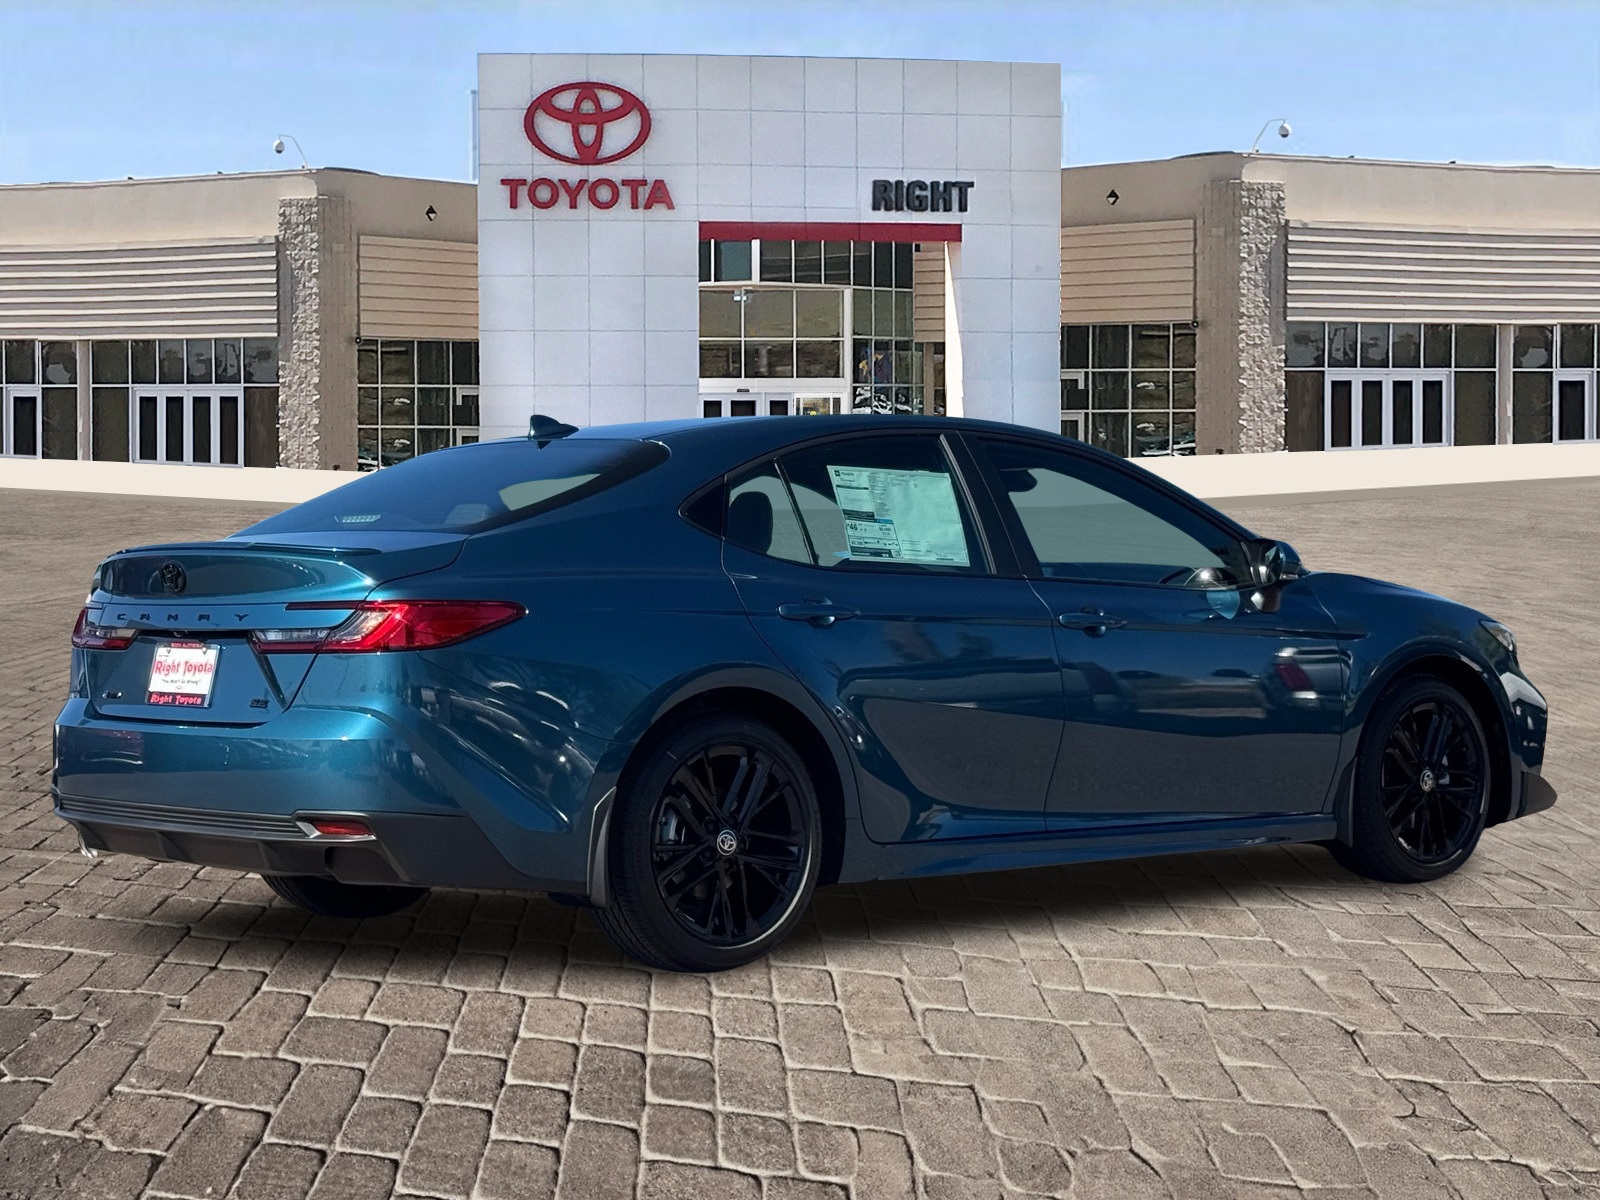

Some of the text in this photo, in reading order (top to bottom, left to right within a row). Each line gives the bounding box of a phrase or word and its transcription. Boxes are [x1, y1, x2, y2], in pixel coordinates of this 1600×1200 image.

[500, 178, 676, 210] TOYOTA
[871, 179, 975, 213] RIGHT
[117, 613, 249, 621] CAMRY
[155, 660, 213, 676] Right Toyota
[150, 693, 202, 705] Right Toyota
